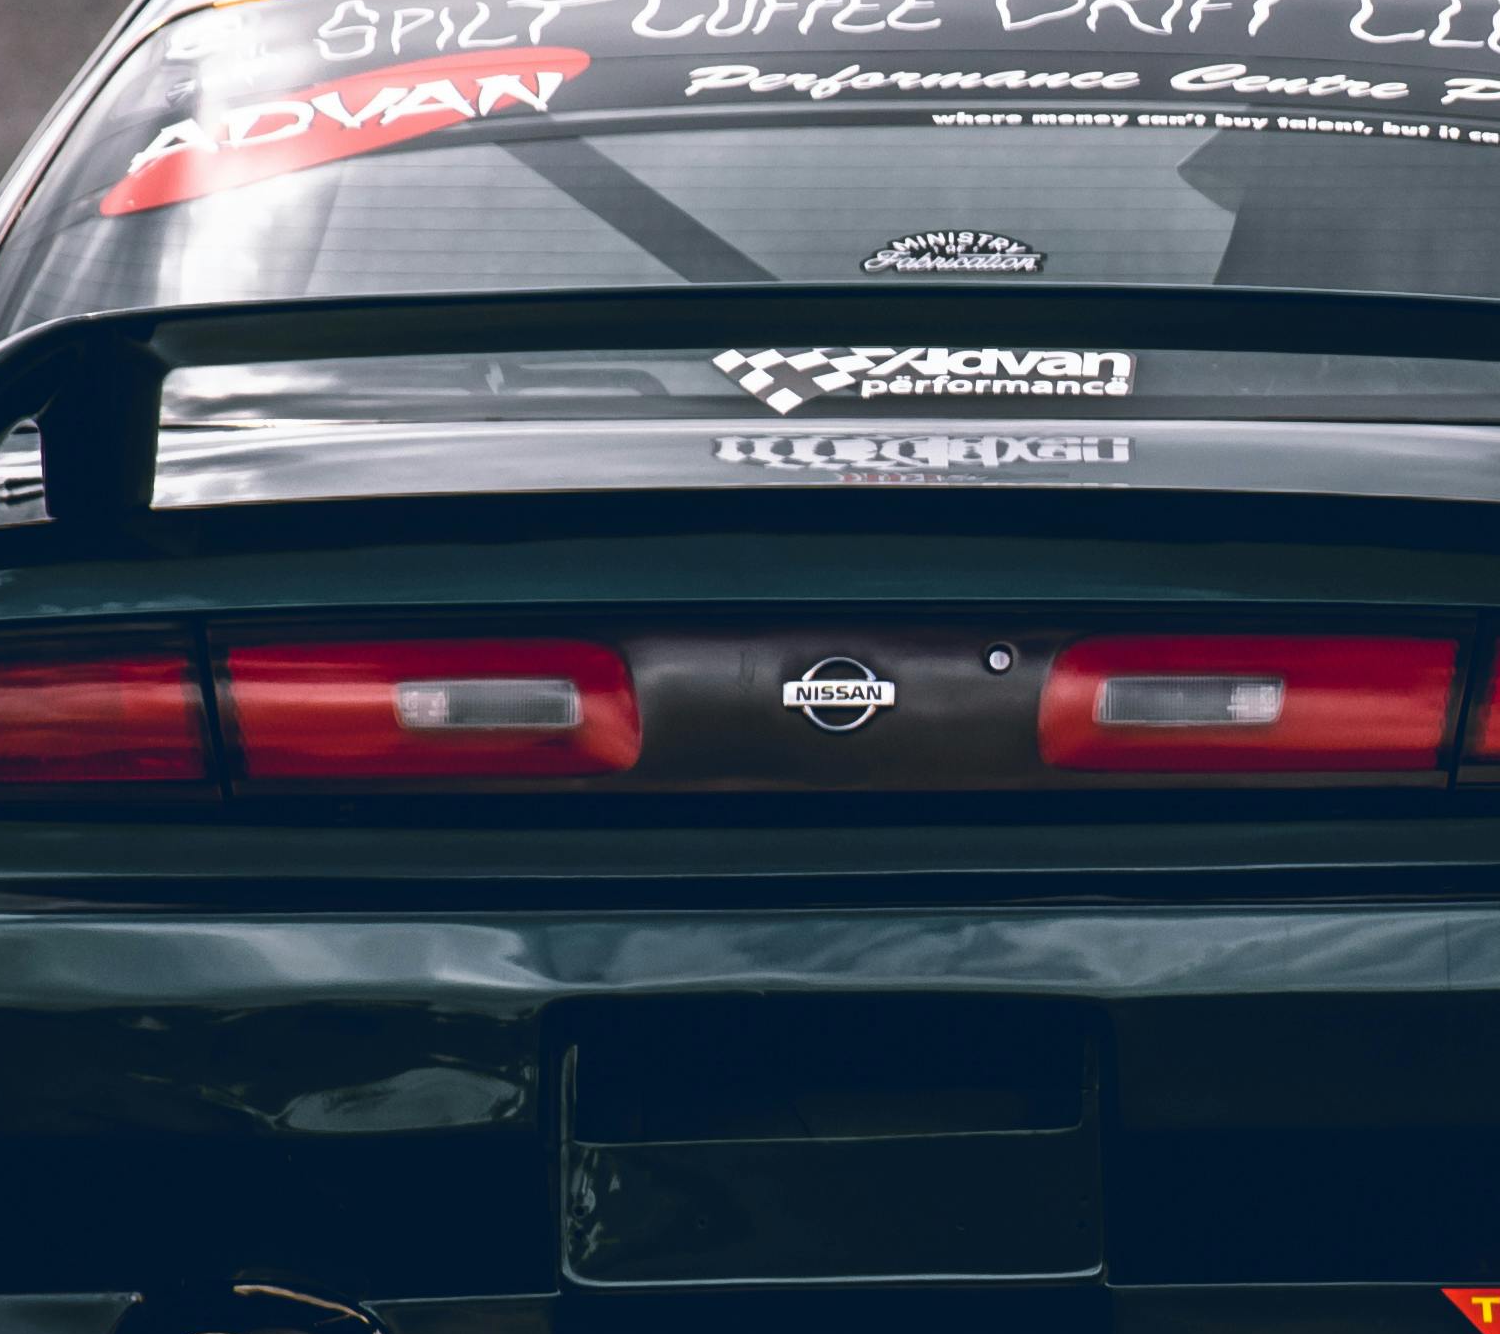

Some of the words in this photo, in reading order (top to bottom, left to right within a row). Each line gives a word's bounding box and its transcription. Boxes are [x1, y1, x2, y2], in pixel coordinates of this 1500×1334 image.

[685, 65, 1140, 99] Performance
[1171, 64, 1409, 99] Centre
[126, 69, 566, 173] ADVAN
[932, 111, 1024, 125] where
[1032, 113, 1129, 128] money
[1137, 113, 1207, 127] can't
[1215, 113, 1269, 131] buy
[1277, 116, 1374, 135] talent,
[1382, 121, 1431, 138] but
[1439, 125, 1461, 140] it
[892, 231, 1027, 254] MINISTRY
[865, 347, 1132, 377] Advan
[796, 685, 882, 701] NISSAN
